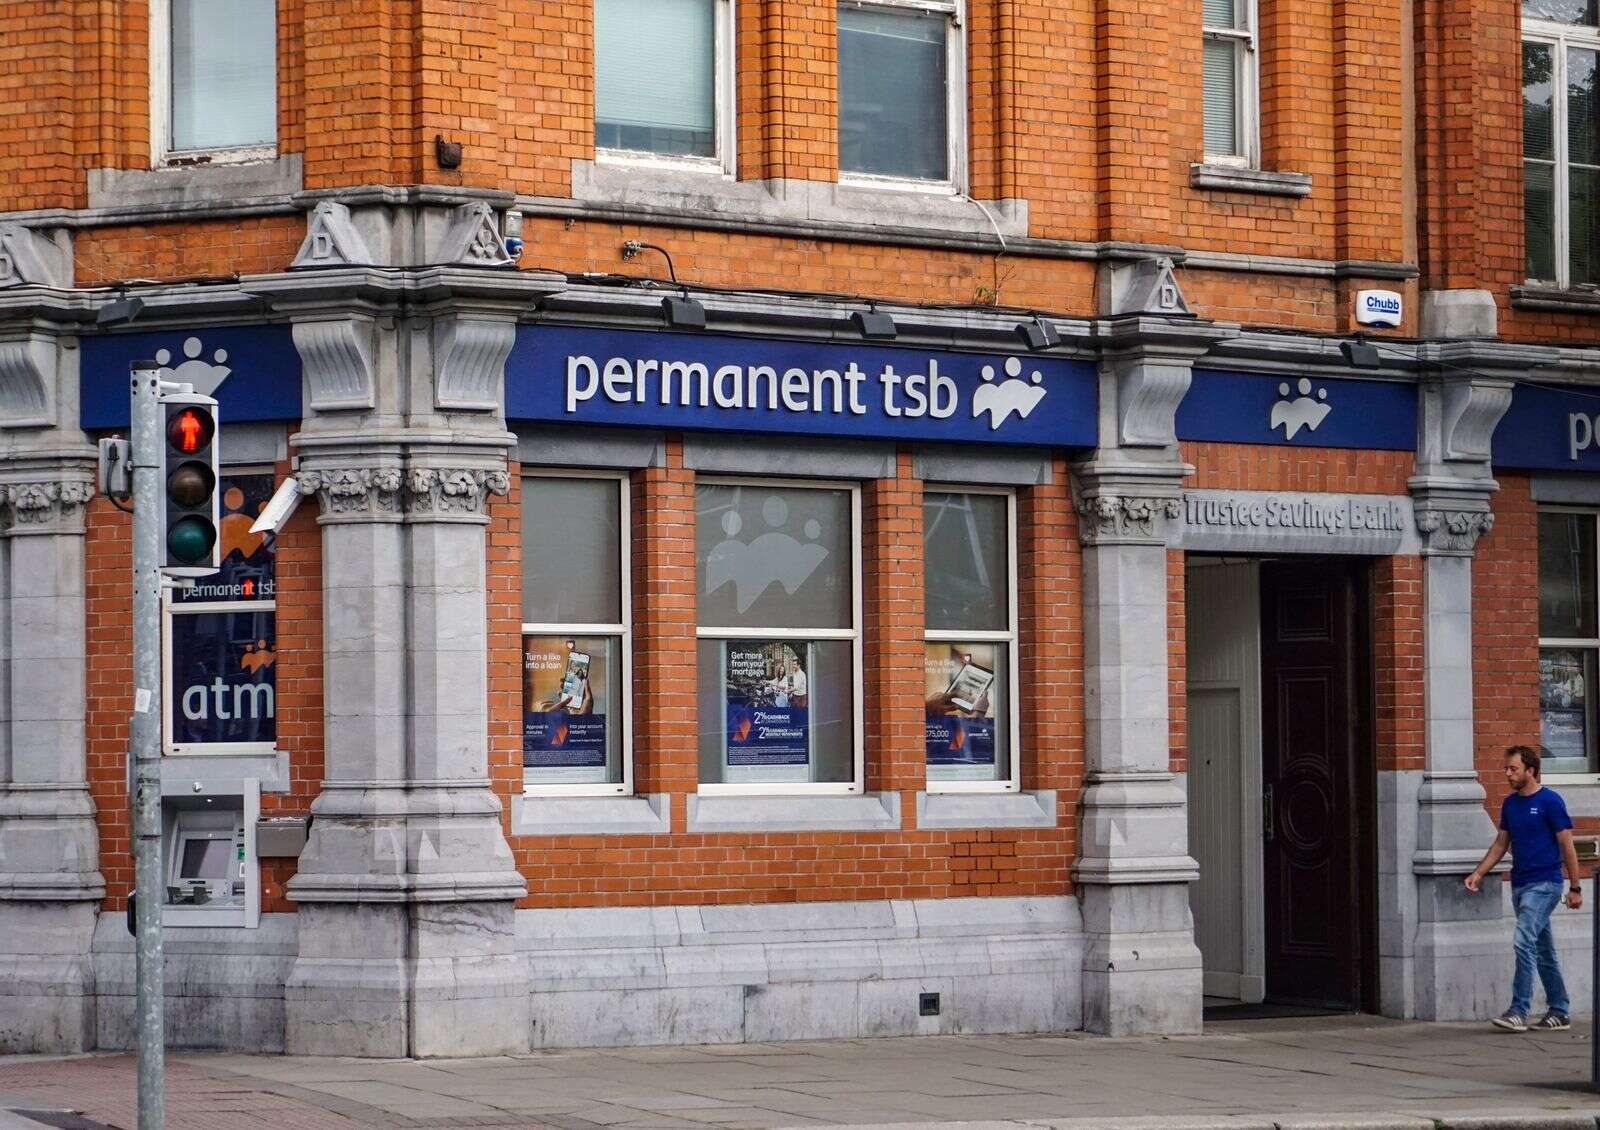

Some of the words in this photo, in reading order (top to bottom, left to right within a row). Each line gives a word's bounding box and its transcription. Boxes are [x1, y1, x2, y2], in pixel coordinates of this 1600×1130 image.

[1366, 296, 1400, 310] Chubb
[567, 355, 866, 414] permanent
[880, 359, 958, 418] tsb
[1184, 493, 1265, 527] Trustee
[1265, 496, 1345, 534] Savings
[1349, 500, 1404, 531] Bank
[183, 580, 255, 599] permanent
[525, 652, 541, 660] Turn
[731, 651, 743, 659] Get
[525, 660, 539, 669] into
[546, 661, 562, 669] loan
[731, 668, 764, 677] mortgage
[182, 676, 274, 720] atm
